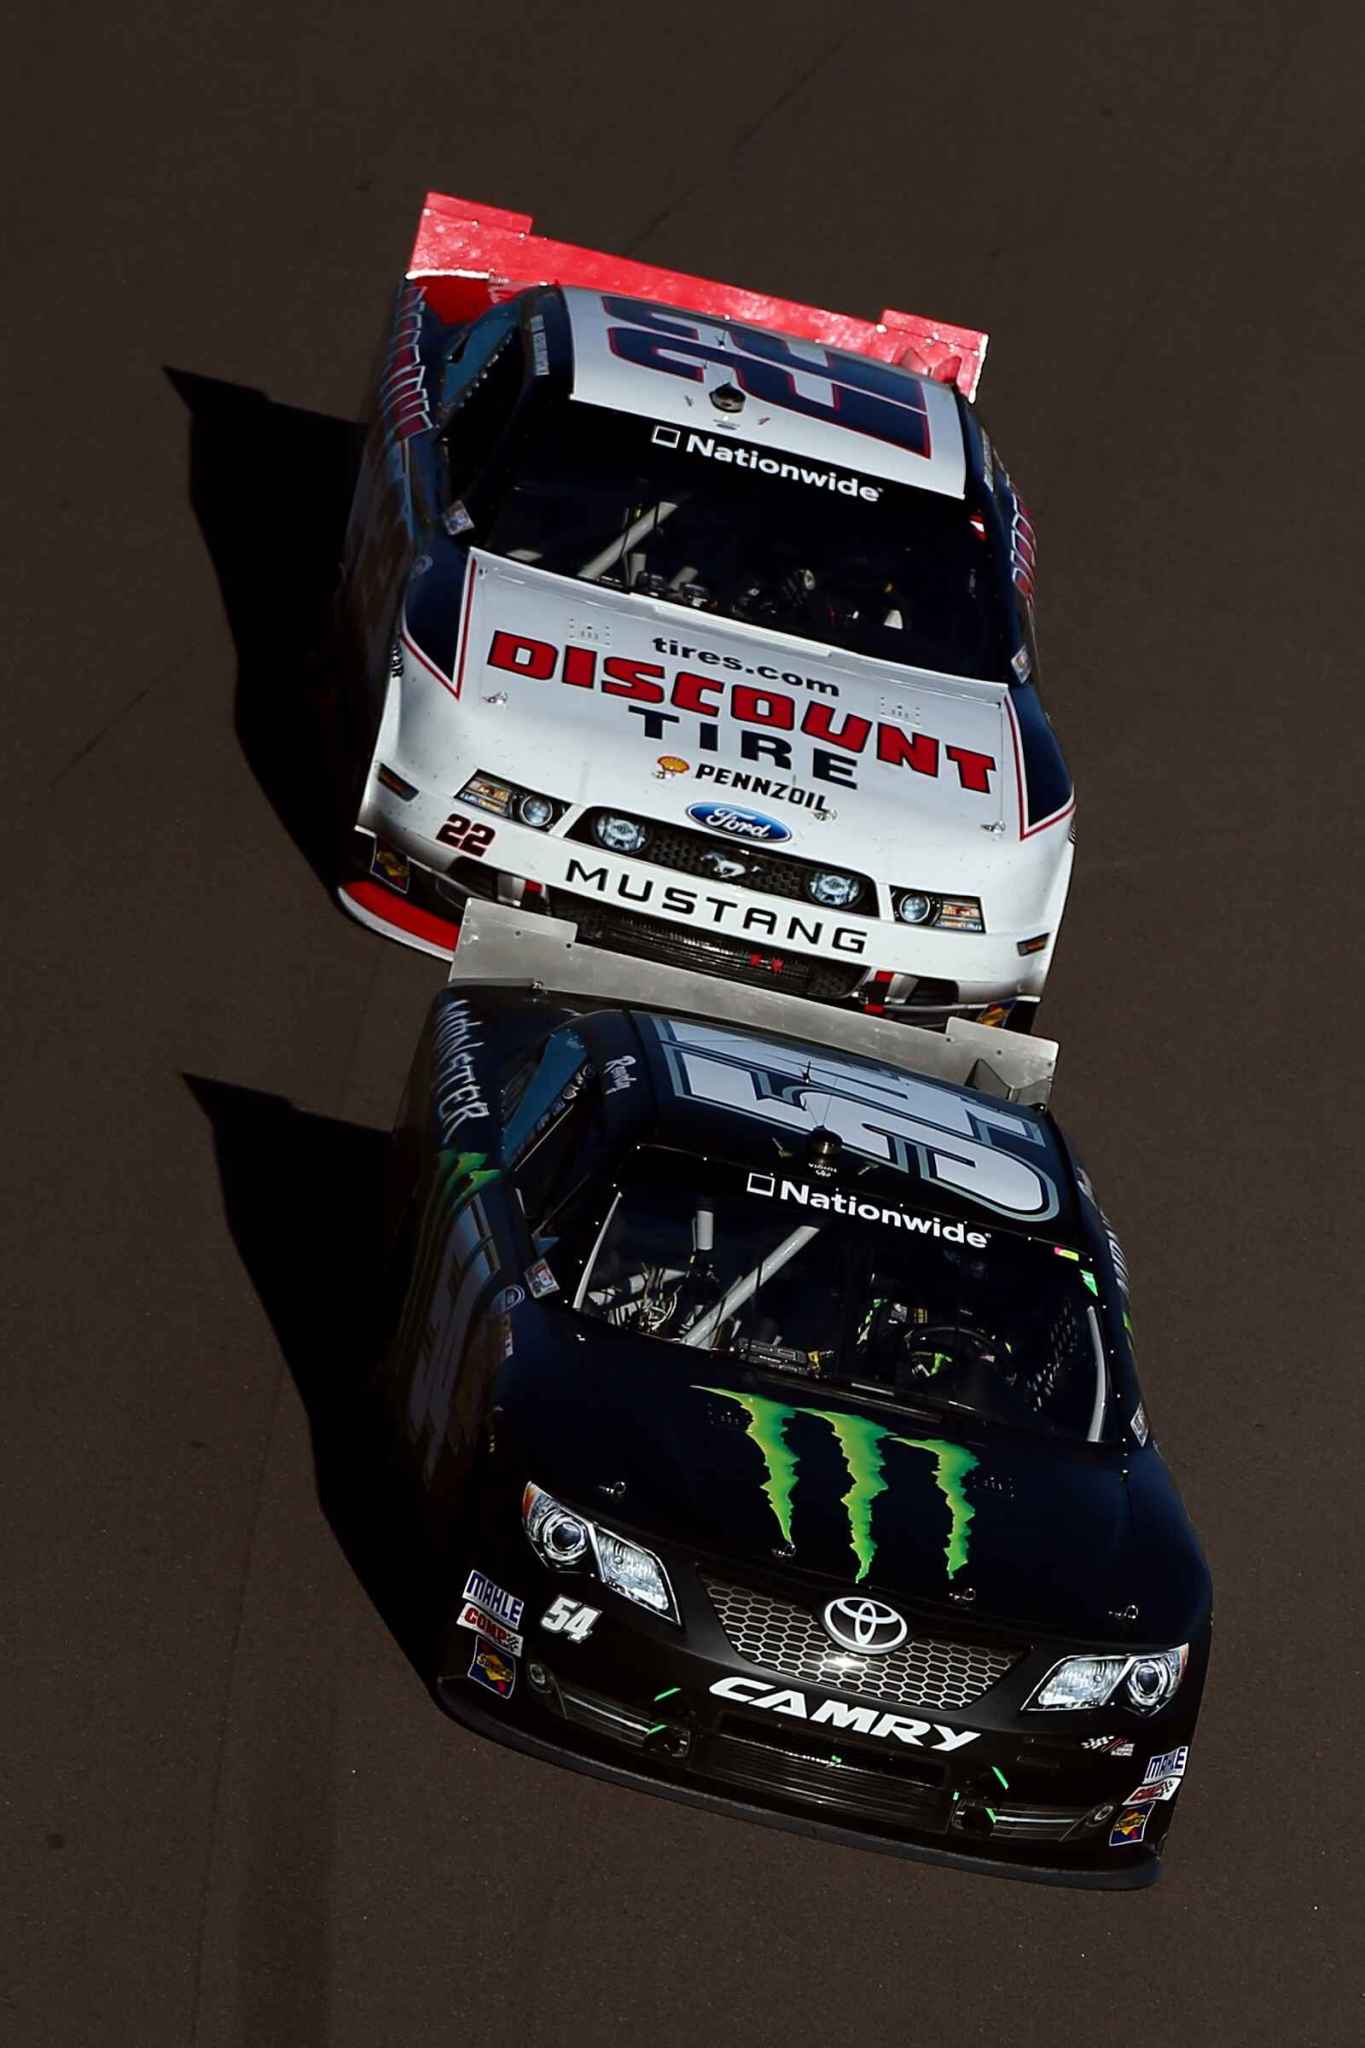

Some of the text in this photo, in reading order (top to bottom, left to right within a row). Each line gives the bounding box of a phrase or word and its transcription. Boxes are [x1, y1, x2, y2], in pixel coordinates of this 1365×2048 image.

[686, 433, 881, 503] Nationwide
[652, 636, 840, 697] tires.com
[486, 630, 997, 794] DISCOUNT
[627, 704, 859, 790] TIRE
[695, 763, 830, 813] PENNZOIL
[435, 813, 497, 858] 22
[704, 806, 773, 840] Ford
[564, 858, 868, 955] MUSTANG
[778, 1180, 988, 1250] Nationwide
[466, 1572, 524, 1624] MAHLE
[540, 1594, 603, 1644] 54
[708, 1676, 982, 1752] CAMRY
